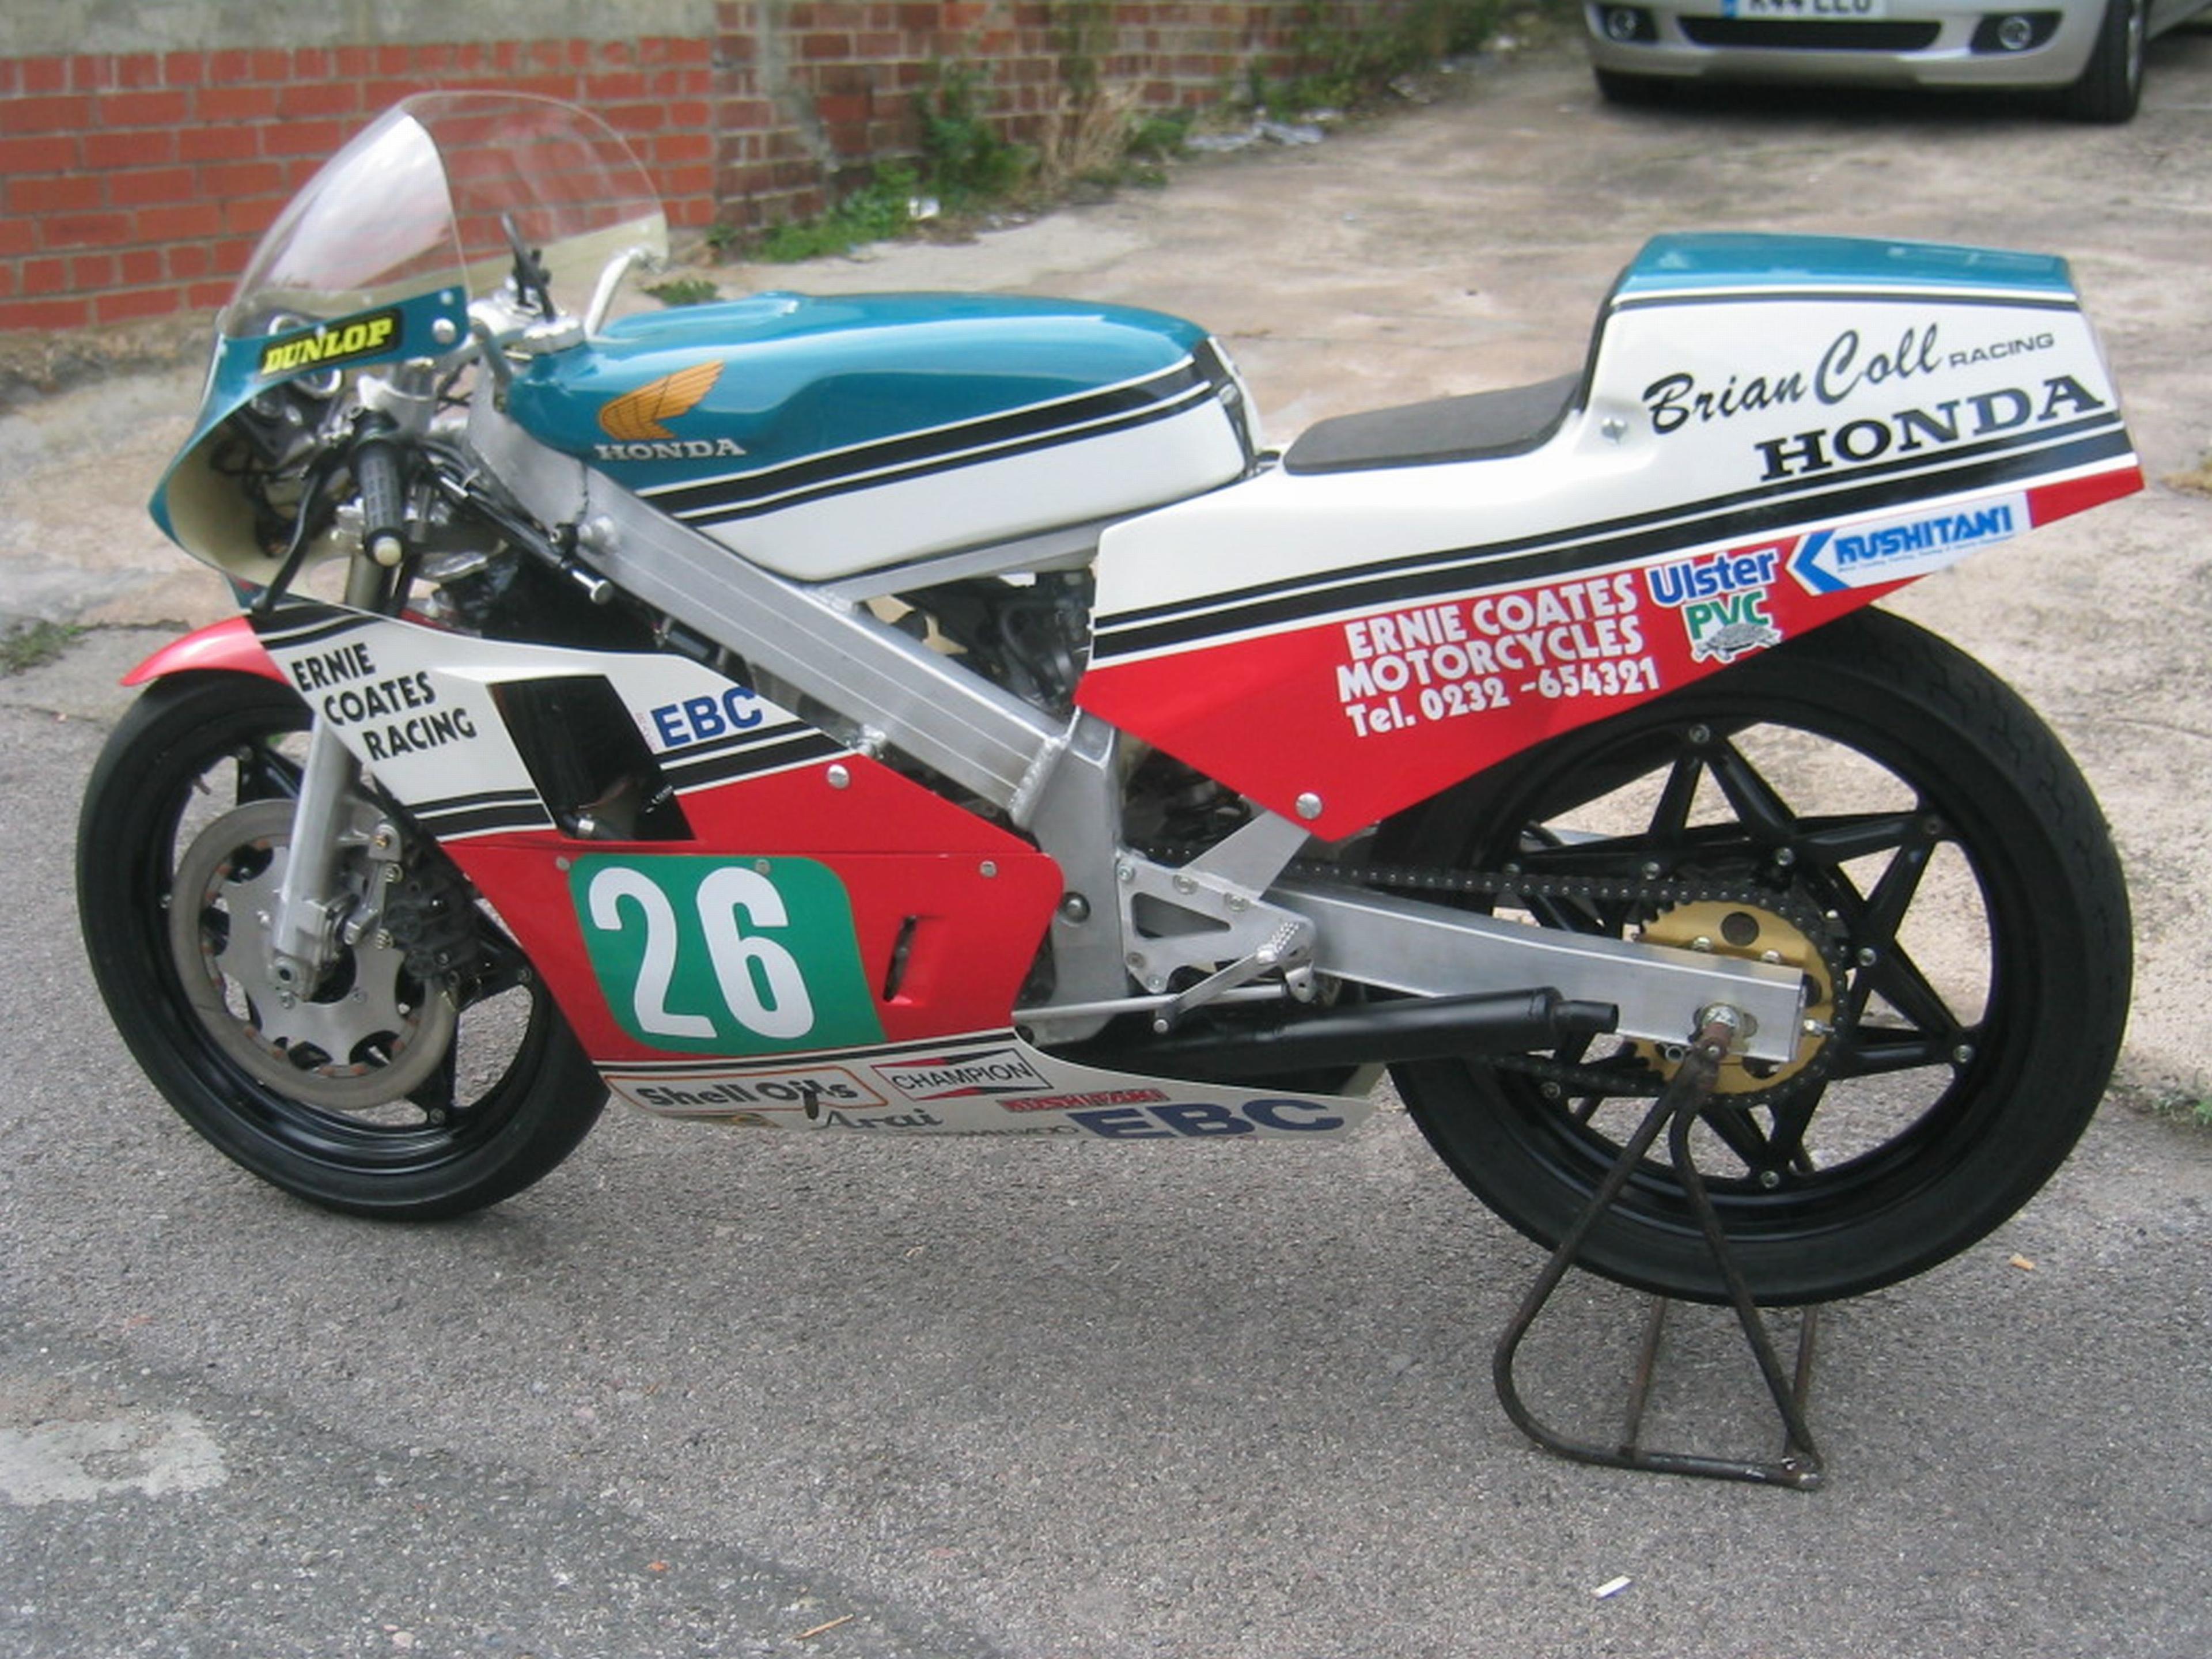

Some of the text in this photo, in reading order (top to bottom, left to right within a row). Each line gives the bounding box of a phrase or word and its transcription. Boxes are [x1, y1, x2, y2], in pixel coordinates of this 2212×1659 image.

[262, 316, 393, 374] DUNLOP
[1642, 323, 2055, 435] Brian Coll RACING
[594, 439, 747, 460] HONDA
[1754, 374, 2105, 482] HONDA
[1649, 550, 1777, 604] Ulster
[1345, 574, 1638, 661] ERNIE COATES
[1685, 591, 1770, 640] PVC
[291, 643, 376, 693] ERNIE
[1336, 615, 1644, 702] MOTORCYCLES
[323, 671, 436, 726] COATES
[650, 686, 763, 748] EBC
[1346, 657, 1660, 737] Tel. 0232 -654321
[362, 708, 477, 763] RACING
[589, 866, 815, 1039] 26
[636, 1084, 759, 1107] Shell
[892, 1062, 1033, 1091] CHAMPION
[811, 1109, 943, 1130] Arai
[1067, 1099, 1345, 1139] EBC
